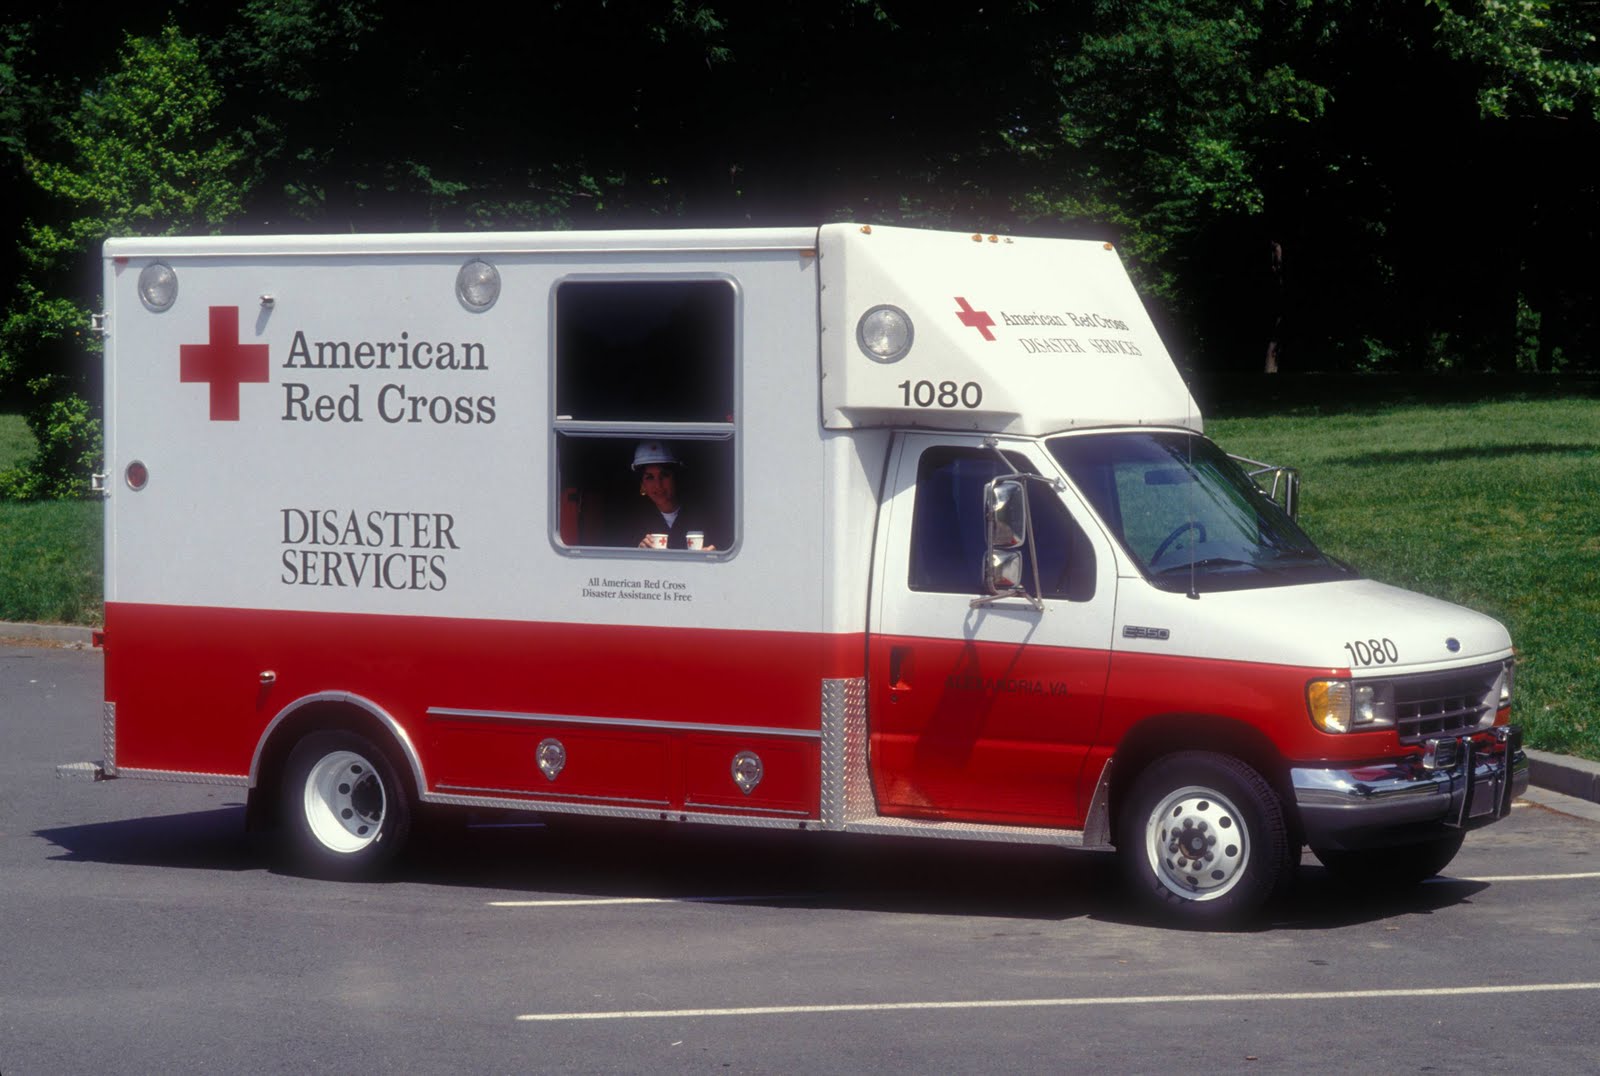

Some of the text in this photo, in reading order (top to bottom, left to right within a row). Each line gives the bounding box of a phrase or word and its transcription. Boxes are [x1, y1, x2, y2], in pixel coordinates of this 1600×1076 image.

[1000, 311, 1130, 331] American Red Cross
[283, 330, 489, 371] American
[1018, 338, 1142, 356] DISASTER SERVICES
[281, 383, 497, 425] Red Cross
[898, 380, 983, 409] 1080
[280, 508, 460, 550] DISASTER
[280, 549, 448, 591] SERVICES
[588, 577, 686, 590] All American Red Cross
[582, 588, 693, 602] Disaster Assistance Is Free
[1124, 626, 1169, 640] E350
[1344, 637, 1399, 666] 1080
